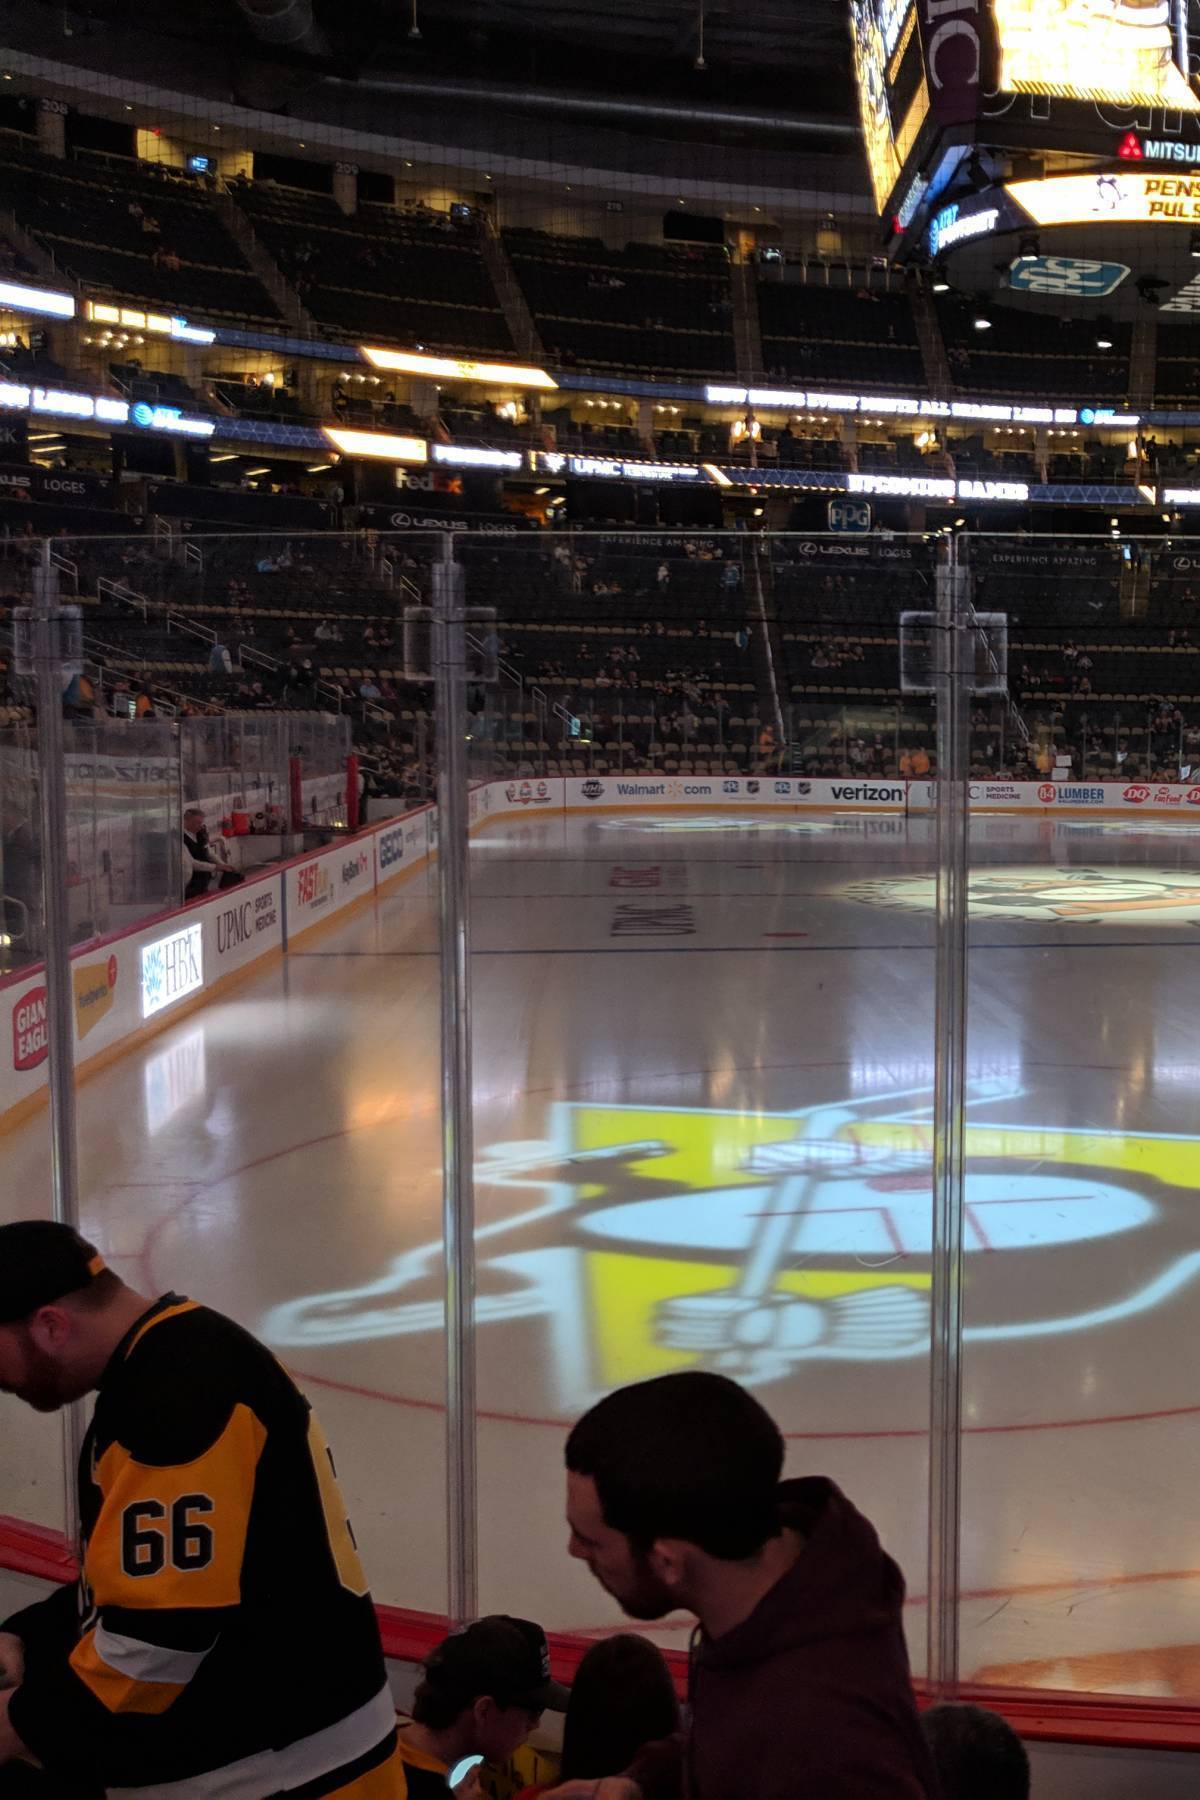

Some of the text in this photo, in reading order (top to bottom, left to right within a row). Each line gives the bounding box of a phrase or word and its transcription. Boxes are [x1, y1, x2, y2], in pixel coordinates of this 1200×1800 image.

[44, 478, 87, 495] LOGES
[395, 467, 464, 494] FedEx
[412, 518, 470, 530] LEXUS
[830, 502, 871, 530] PPG
[817, 545, 870, 556] LEXUS
[616, 783, 711, 796] Walmart com
[831, 783, 902, 802] verizon
[927, 786, 980, 800] UC
[1039, 786, 1054, 799] 84
[1058, 787, 1105, 800] LUMBER
[216, 901, 252, 954] UPMC
[164, 929, 201, 996] HBK
[17, 997, 47, 1032] GIAN
[18, 1025, 48, 1062] EAGL
[122, 1490, 215, 1579] 66
